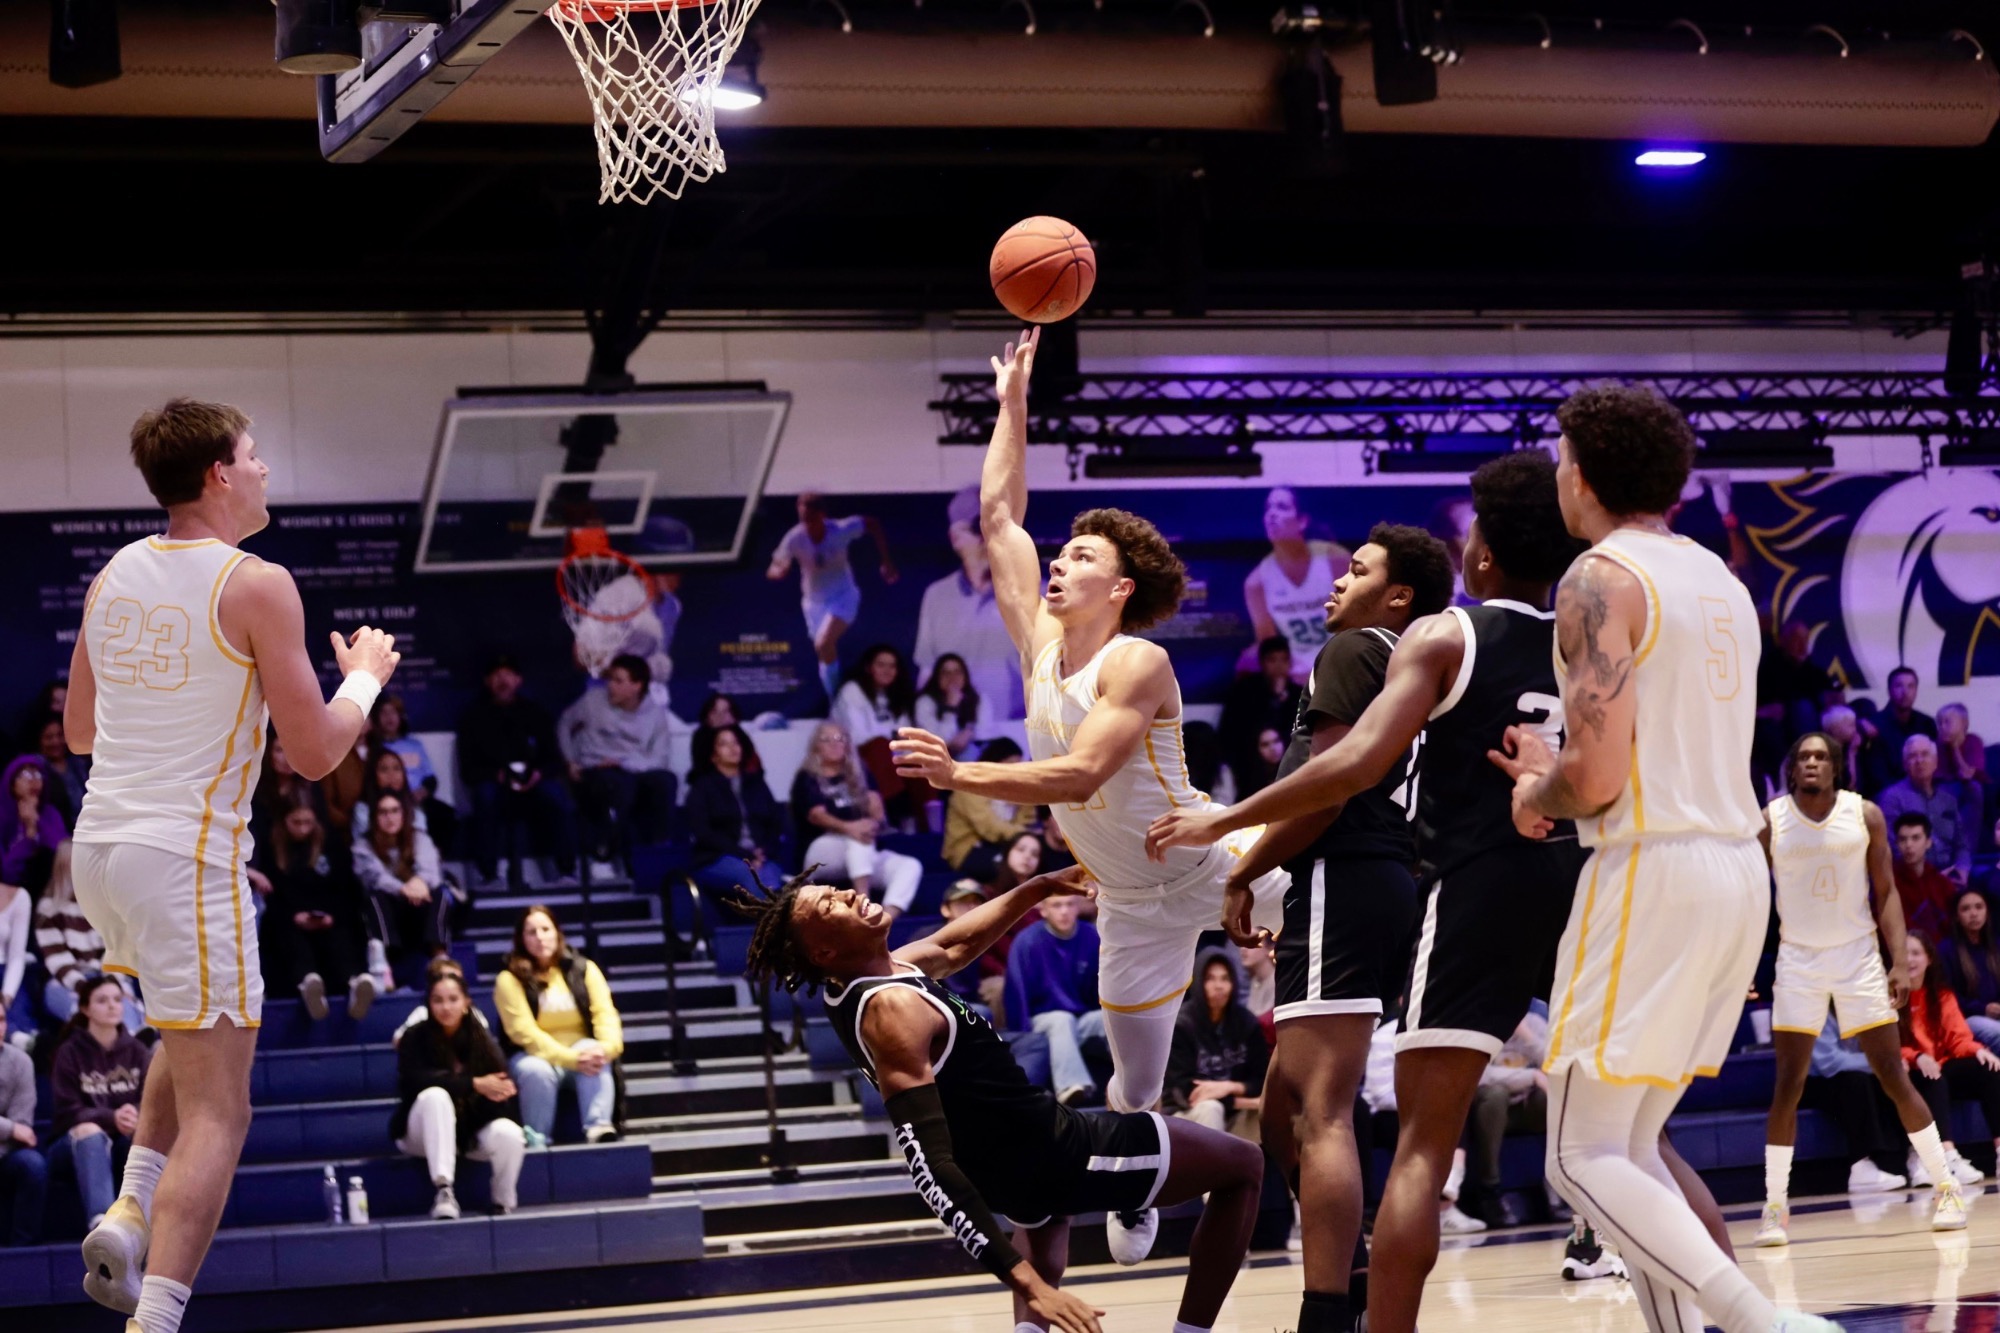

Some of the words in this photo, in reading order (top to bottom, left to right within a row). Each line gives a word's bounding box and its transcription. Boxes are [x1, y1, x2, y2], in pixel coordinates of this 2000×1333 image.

[101, 596, 191, 691] 23
[1288, 615, 1328, 645] 25
[1698, 596, 1741, 701] 5
[1811, 863, 1839, 902] 4
